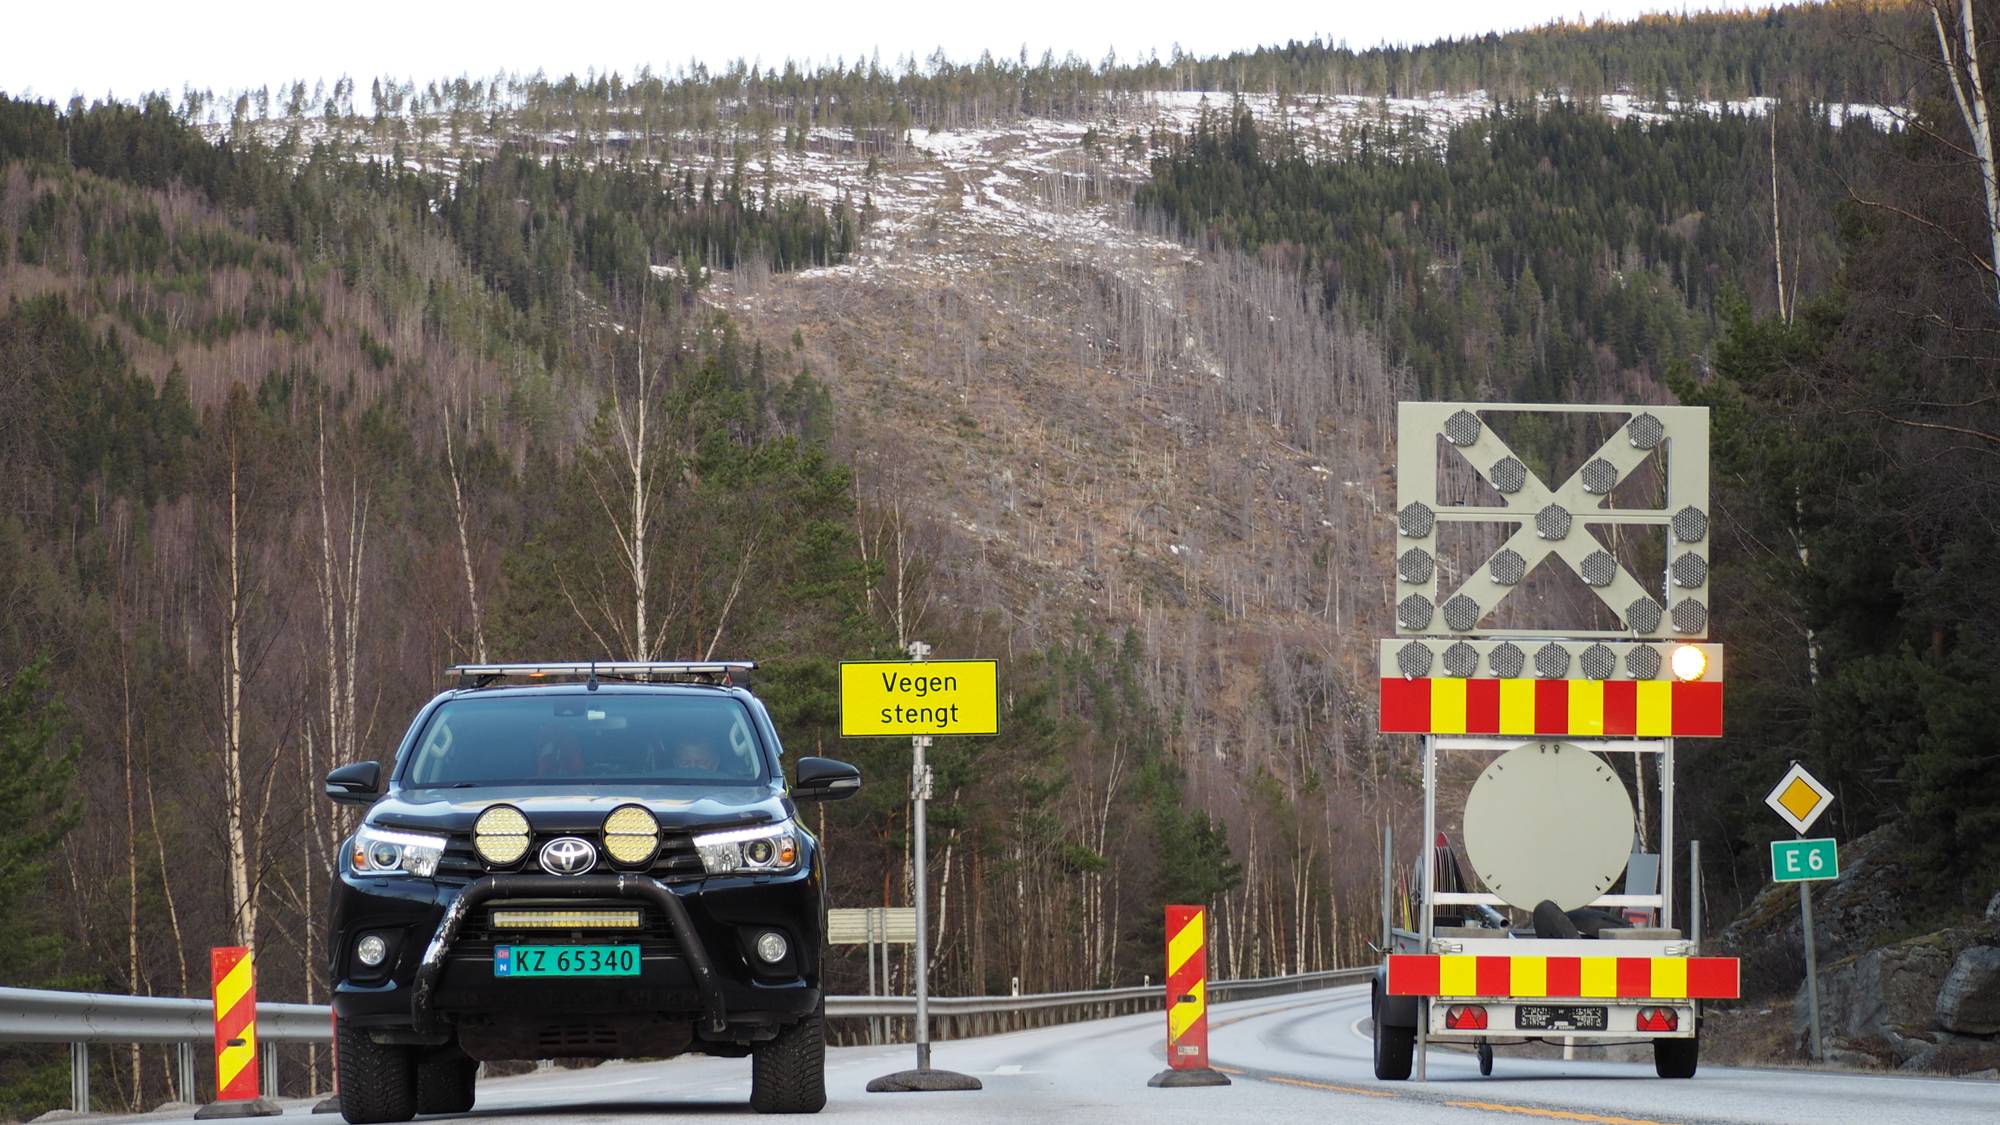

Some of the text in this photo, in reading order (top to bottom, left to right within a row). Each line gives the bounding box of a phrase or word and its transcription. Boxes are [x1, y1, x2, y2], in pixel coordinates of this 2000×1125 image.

[882, 672, 957, 697] Vegen
[881, 703, 959, 728] stengt
[1786, 848, 1824, 873] E 6
[499, 964, 507, 972] N
[516, 950, 633, 972] KZ 65340
